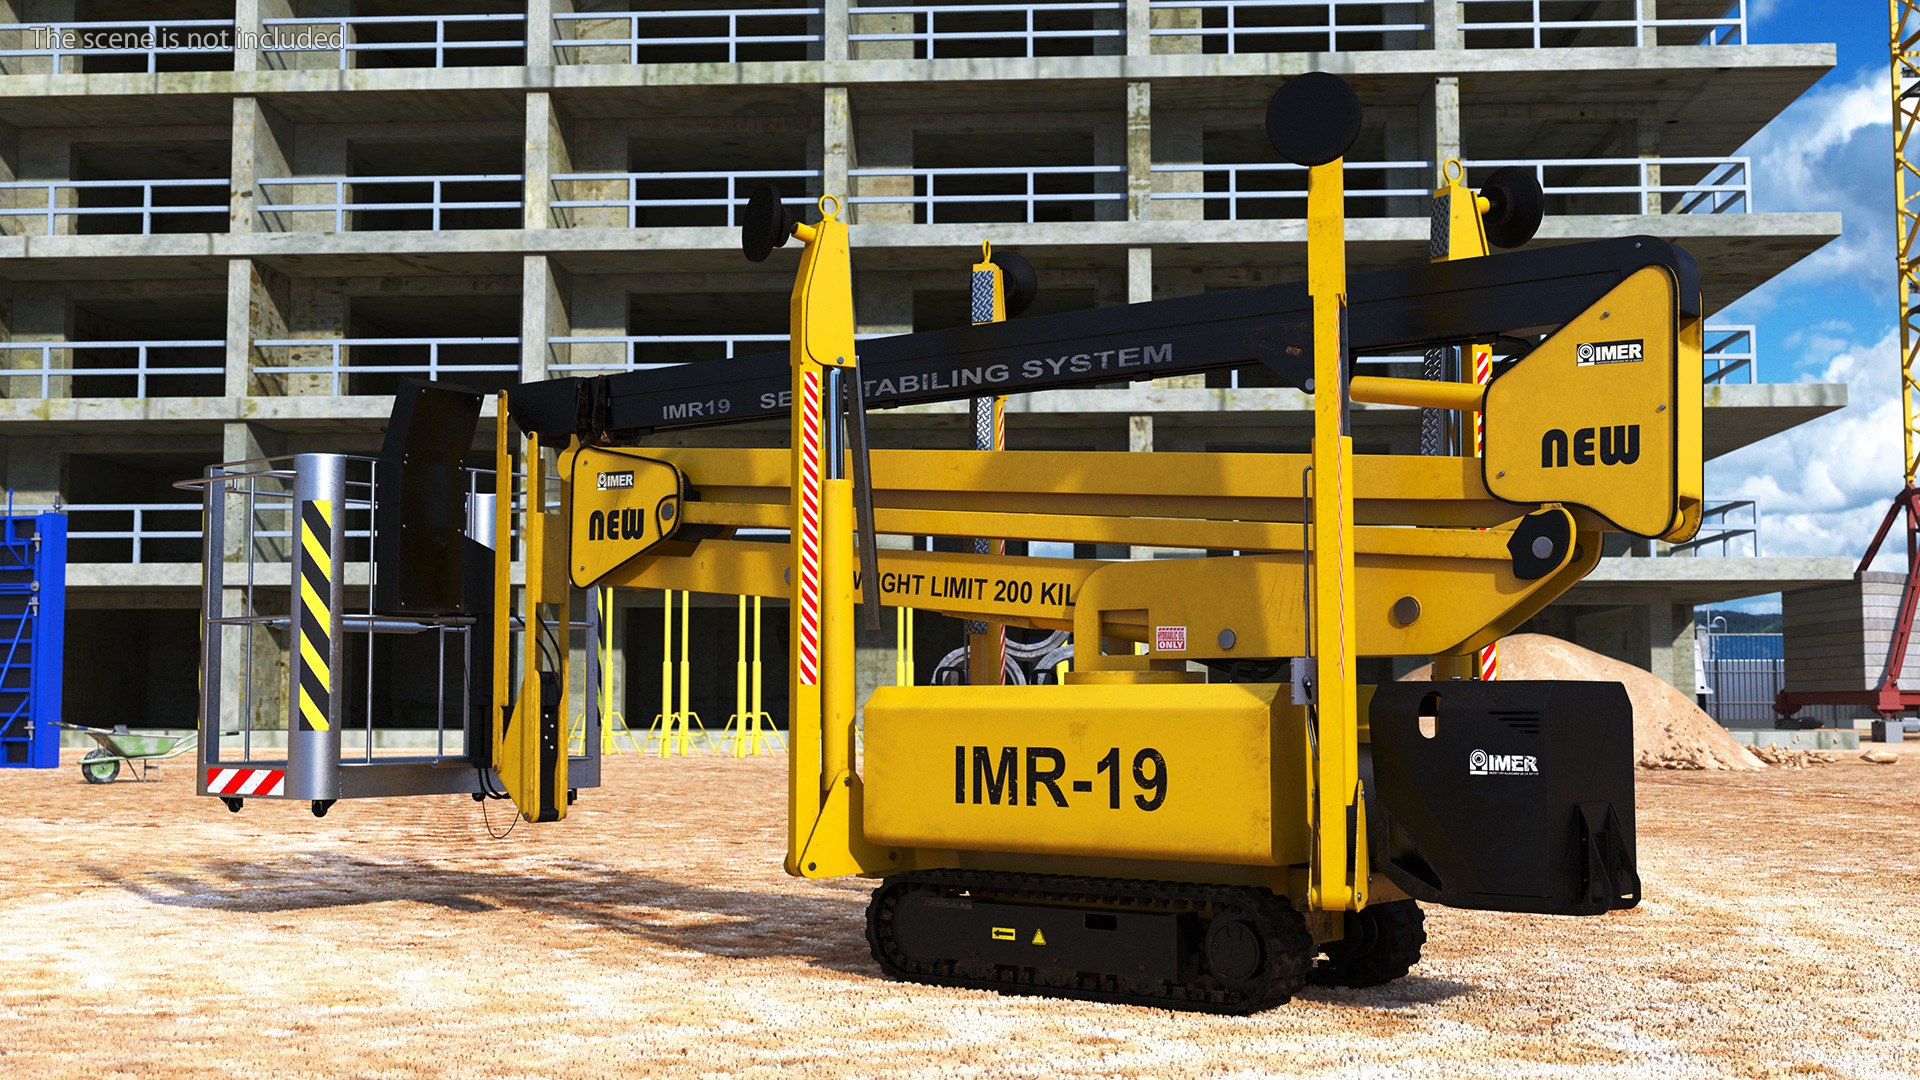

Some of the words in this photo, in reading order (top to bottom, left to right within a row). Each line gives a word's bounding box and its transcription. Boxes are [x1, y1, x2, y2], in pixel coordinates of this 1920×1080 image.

[1595, 343, 1642, 361] IMER
[662, 399, 731, 421] IMR19
[1022, 343, 1173, 379] SYSTEM
[1541, 424, 1640, 468] NEW
[608, 474, 633, 487] IMER
[589, 509, 644, 540] NEW
[930, 575, 988, 600] LIMIT
[993, 579, 1033, 604] 200
[1159, 641, 1183, 649] ONLY
[1488, 754, 1538, 772] IMER
[955, 745, 1168, 812] IMR-19
